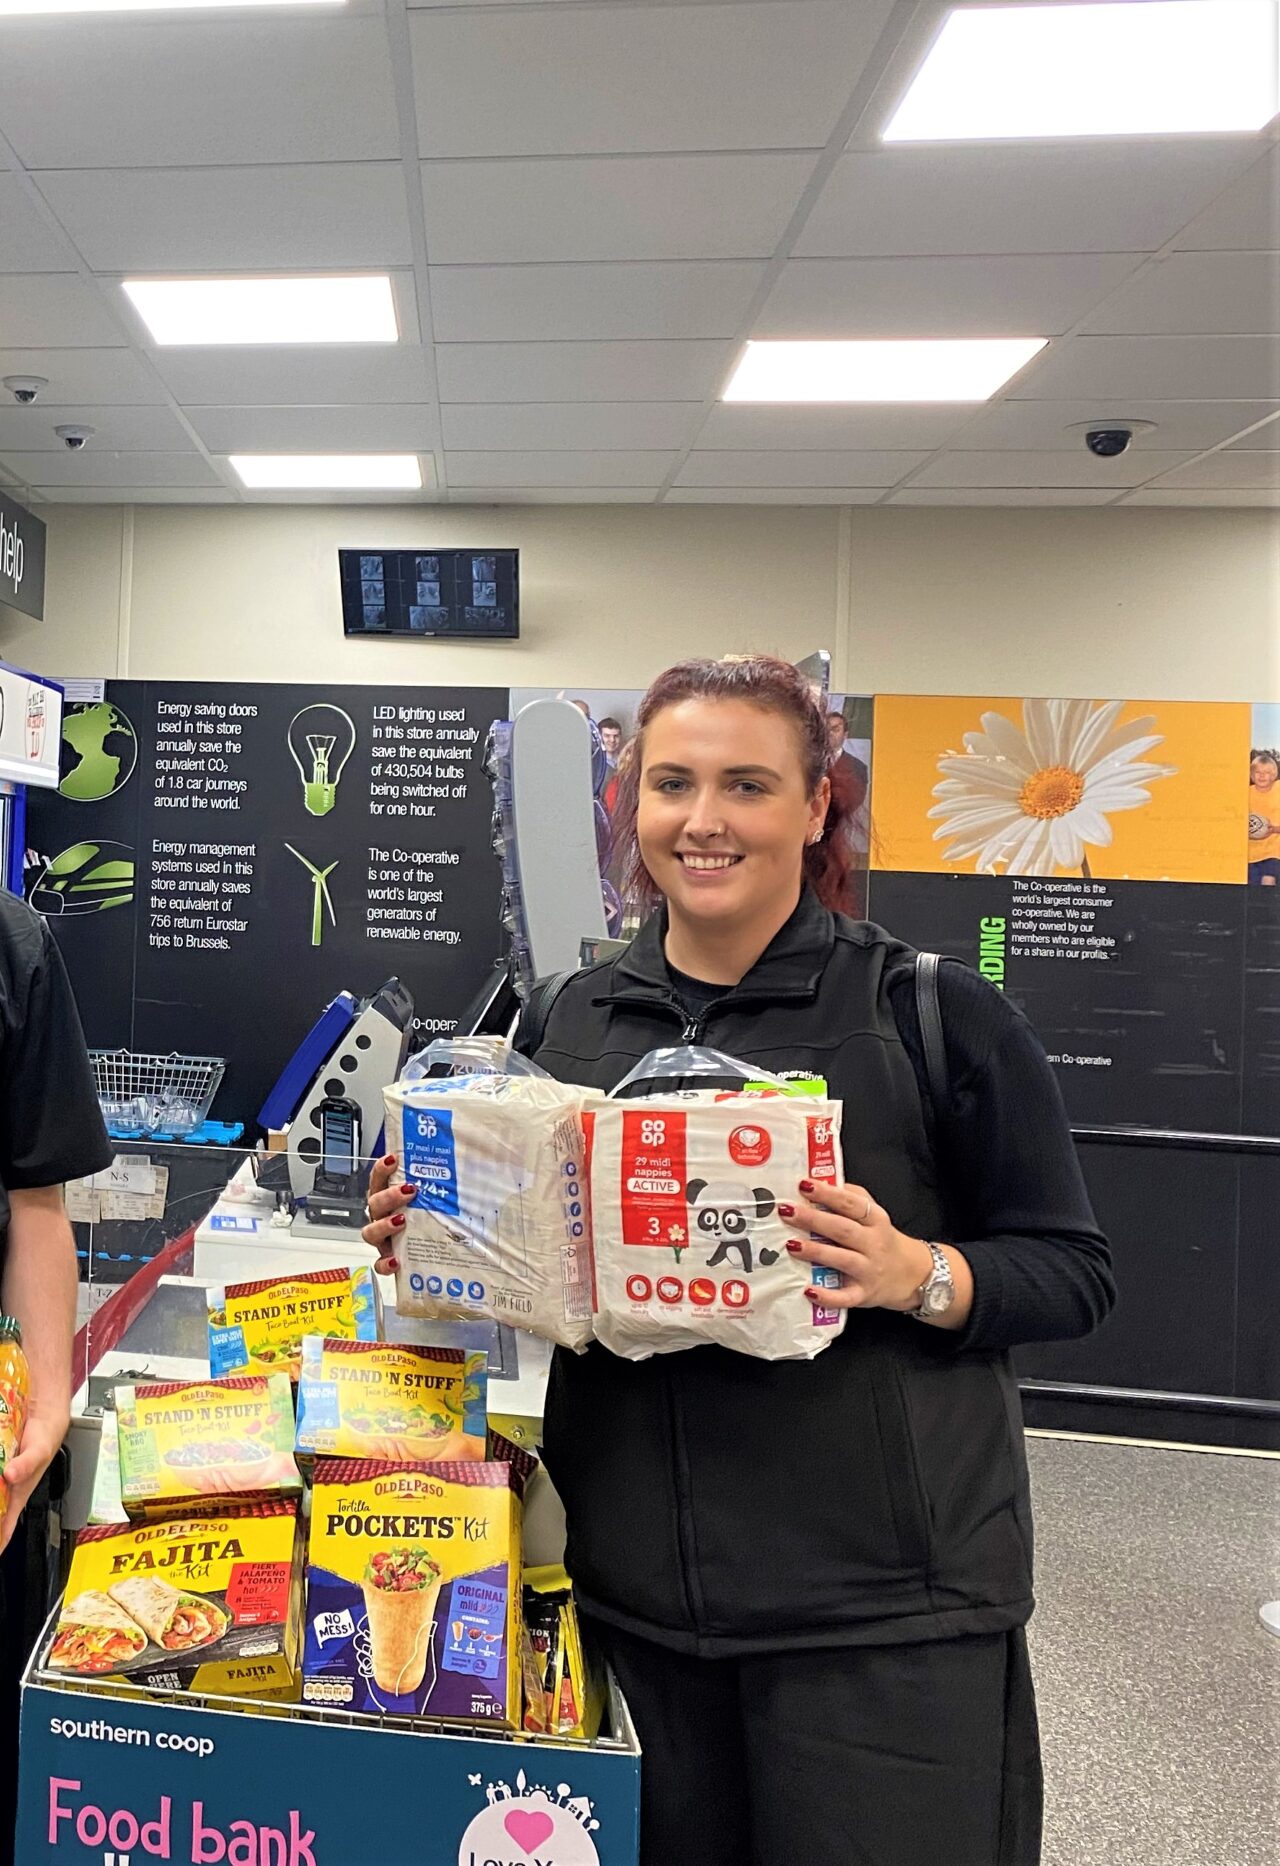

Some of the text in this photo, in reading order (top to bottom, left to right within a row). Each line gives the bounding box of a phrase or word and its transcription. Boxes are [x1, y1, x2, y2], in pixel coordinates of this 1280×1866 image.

[0, 512, 23, 593] help
[158, 701, 258, 718] Energy saving doors
[374, 706, 465, 723] LED lighting used
[157, 720, 241, 734] used in this store
[373, 725, 479, 743] in this store annually
[156, 739, 241, 754] annually save the
[156, 758, 205, 772] equivalent
[371, 764, 464, 779] of 430,504 bulbs
[155, 776, 247, 793] of 1.8 car journeys
[154, 796, 240, 809] around the world.
[369, 848, 459, 865] The Co-operative
[369, 867, 433, 882] is one of the
[1013, 881, 1106, 893] The Co-operative is the
[408, 888, 443, 904] largest
[1043, 895, 1070, 906] largest
[1072, 898, 1114, 906] consumer
[367, 908, 437, 921] generators of
[366, 927, 461, 944] renewable energy.
[406, 1142, 414, 1150] 27
[416, 1144, 430, 1152] maxi
[436, 1146, 451, 1154] maxi
[410, 1153, 448, 1165] plus nappies
[635, 1157, 671, 1166] 29 midi
[415, 1165, 446, 1177] ACTIVE
[635, 1167, 672, 1178] nappies
[633, 1180, 674, 1191] ACTIVE
[648, 1217, 660, 1234] 3
[234, 1305, 280, 1323] STAND
[329, 1367, 382, 1382] STAND
[336, 1499, 371, 1513] Tortilla
[464, 1517, 489, 1541] Kit
[109, 1539, 245, 1575] FAJITA
[185, 1562, 212, 1580] Kit
[458, 1585, 505, 1603] ORIGINAL
[460, 1599, 478, 1612] mild
[325, 1613, 341, 1626] NO
[320, 1623, 353, 1636] MESS!
[148, 1673, 179, 1684] OPEN
[227, 1665, 276, 1679] FAJITA
[50, 1717, 150, 1746] southern
[49, 1776, 317, 1866] Food bank
